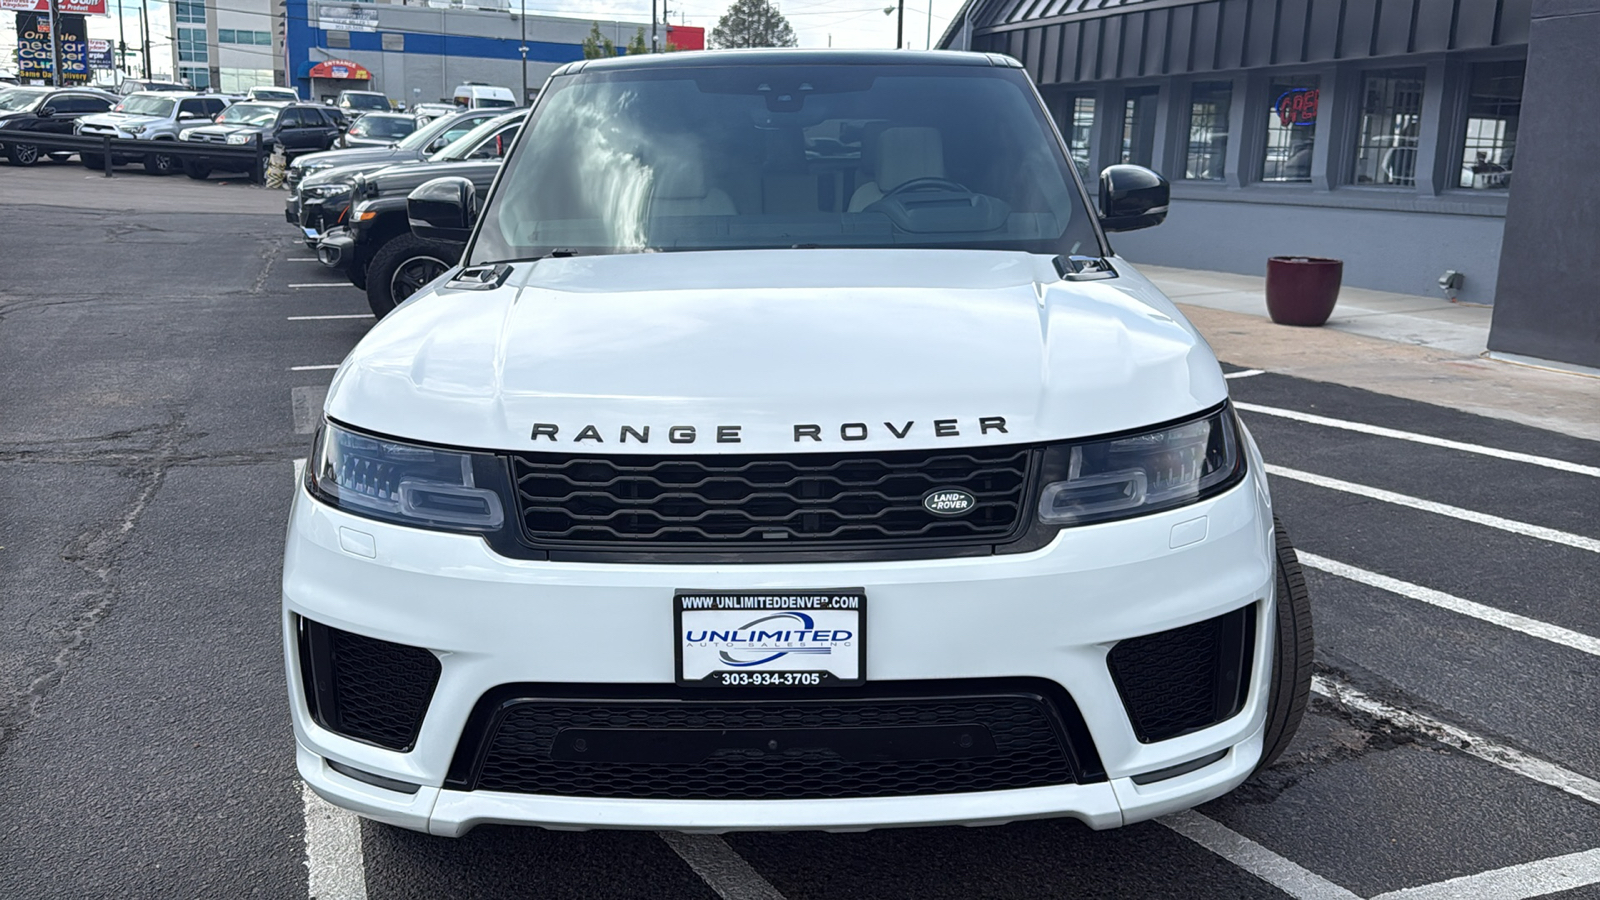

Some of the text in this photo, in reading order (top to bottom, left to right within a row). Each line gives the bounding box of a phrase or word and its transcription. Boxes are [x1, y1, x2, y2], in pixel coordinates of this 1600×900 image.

[24, 31, 44, 40] On
[19, 40, 85, 52] necar
[323, 60, 357, 69] ENTRANCE
[20, 70, 40, 78] Same
[62, 72, 87, 81] elivery
[530, 416, 1009, 444] RANGE ROVER
[681, 596, 859, 609] WWWUNLIMITEDDENVER.COM
[686, 630, 853, 642] UNLIMITED
[721, 673, 820, 685] 303-934-3705
